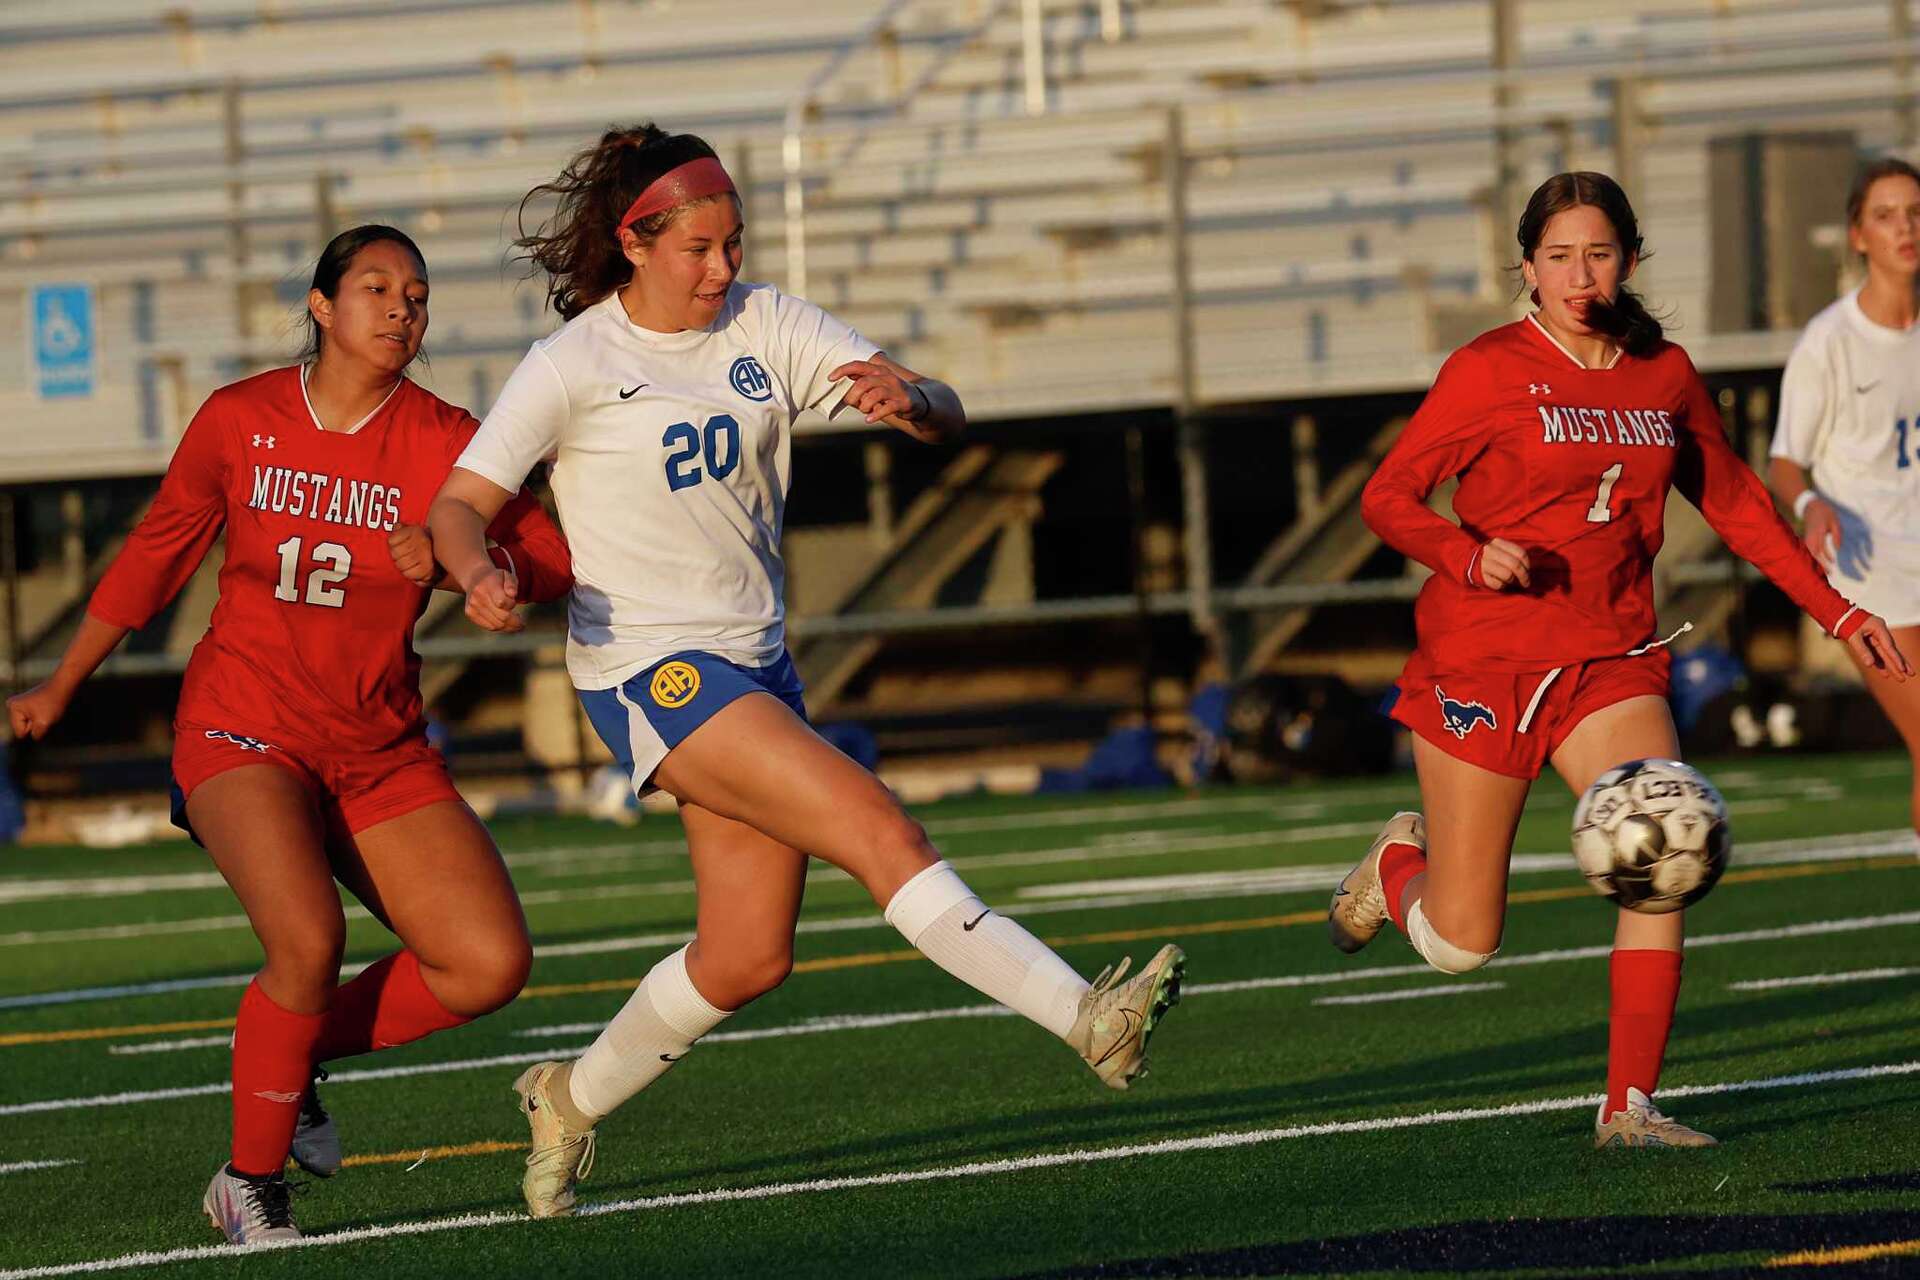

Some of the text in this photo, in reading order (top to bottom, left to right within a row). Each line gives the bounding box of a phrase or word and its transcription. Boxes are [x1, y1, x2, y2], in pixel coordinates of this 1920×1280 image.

[661, 413, 740, 493] 20
[1538, 405, 1676, 447] MUSTANGS
[1896, 414, 1920, 469] 1
[248, 465, 402, 532] MUSTANGS
[1586, 462, 1624, 523] 1
[274, 535, 352, 609] 12
